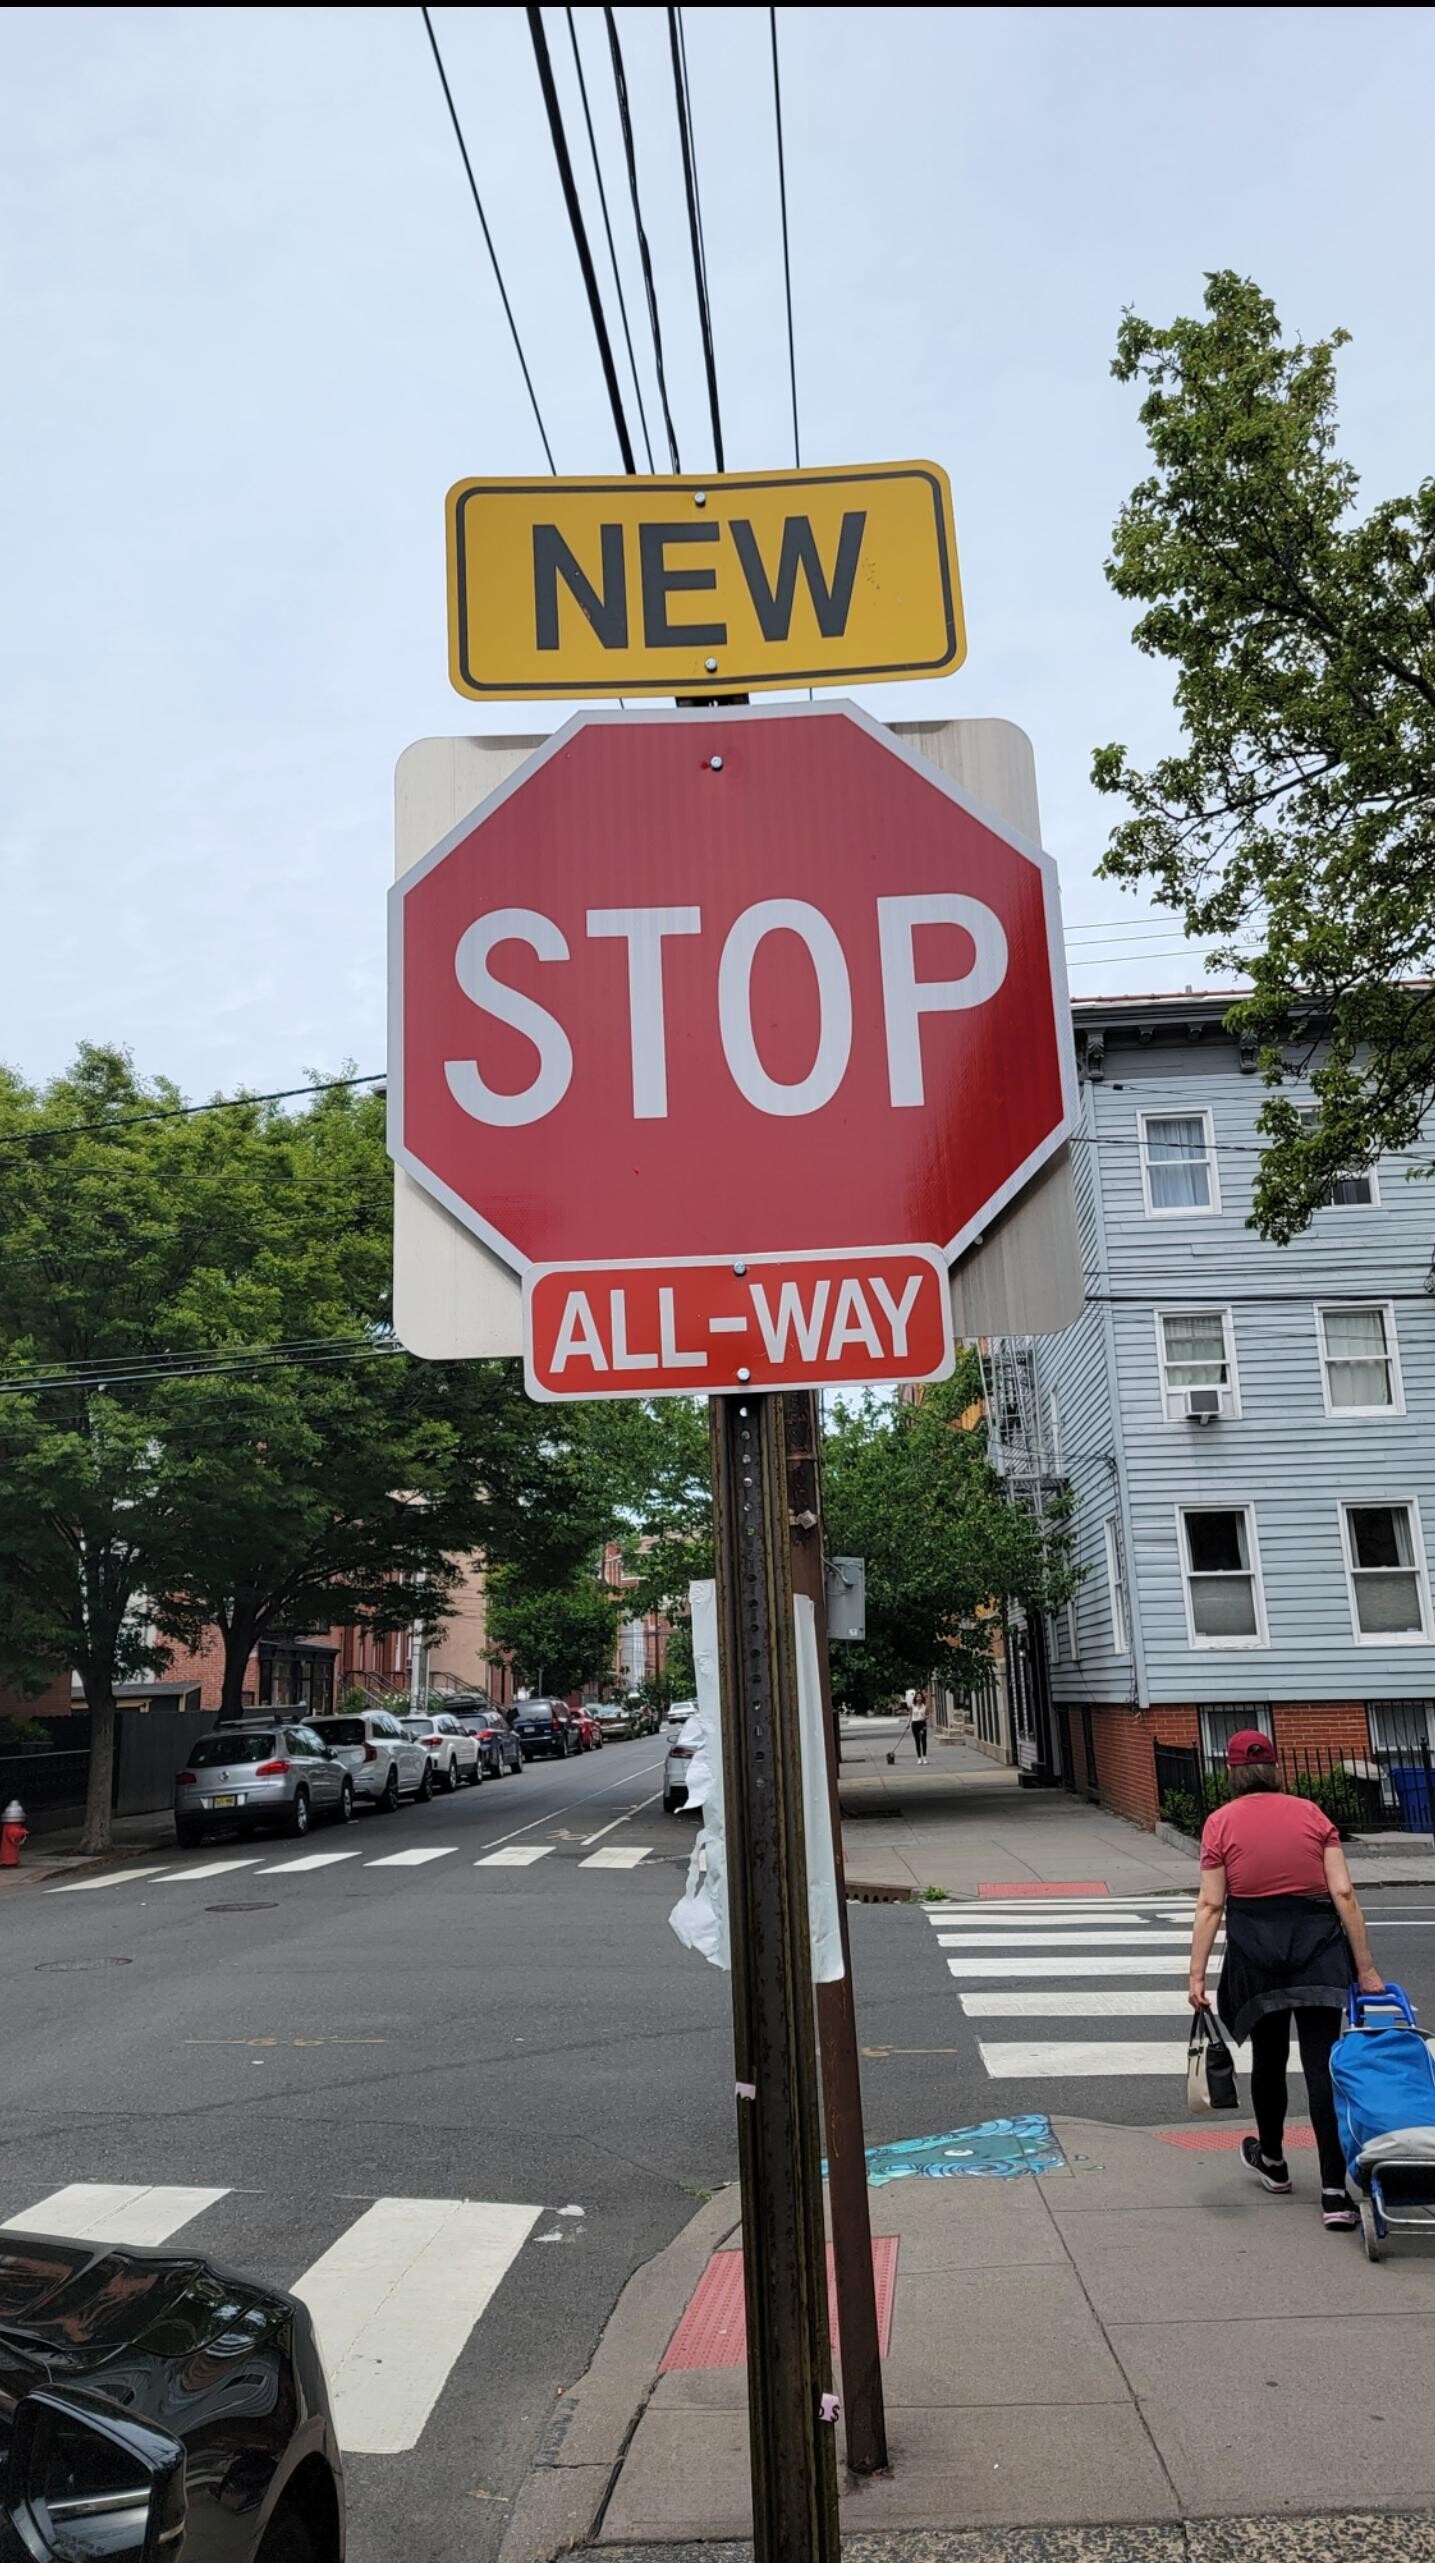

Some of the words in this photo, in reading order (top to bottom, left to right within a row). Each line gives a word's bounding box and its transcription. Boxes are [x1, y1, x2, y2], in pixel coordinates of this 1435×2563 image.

[532, 510, 868, 651] NEW
[443, 892, 1009, 1127] STOP
[548, 1275, 924, 1374] ALL-WAY
